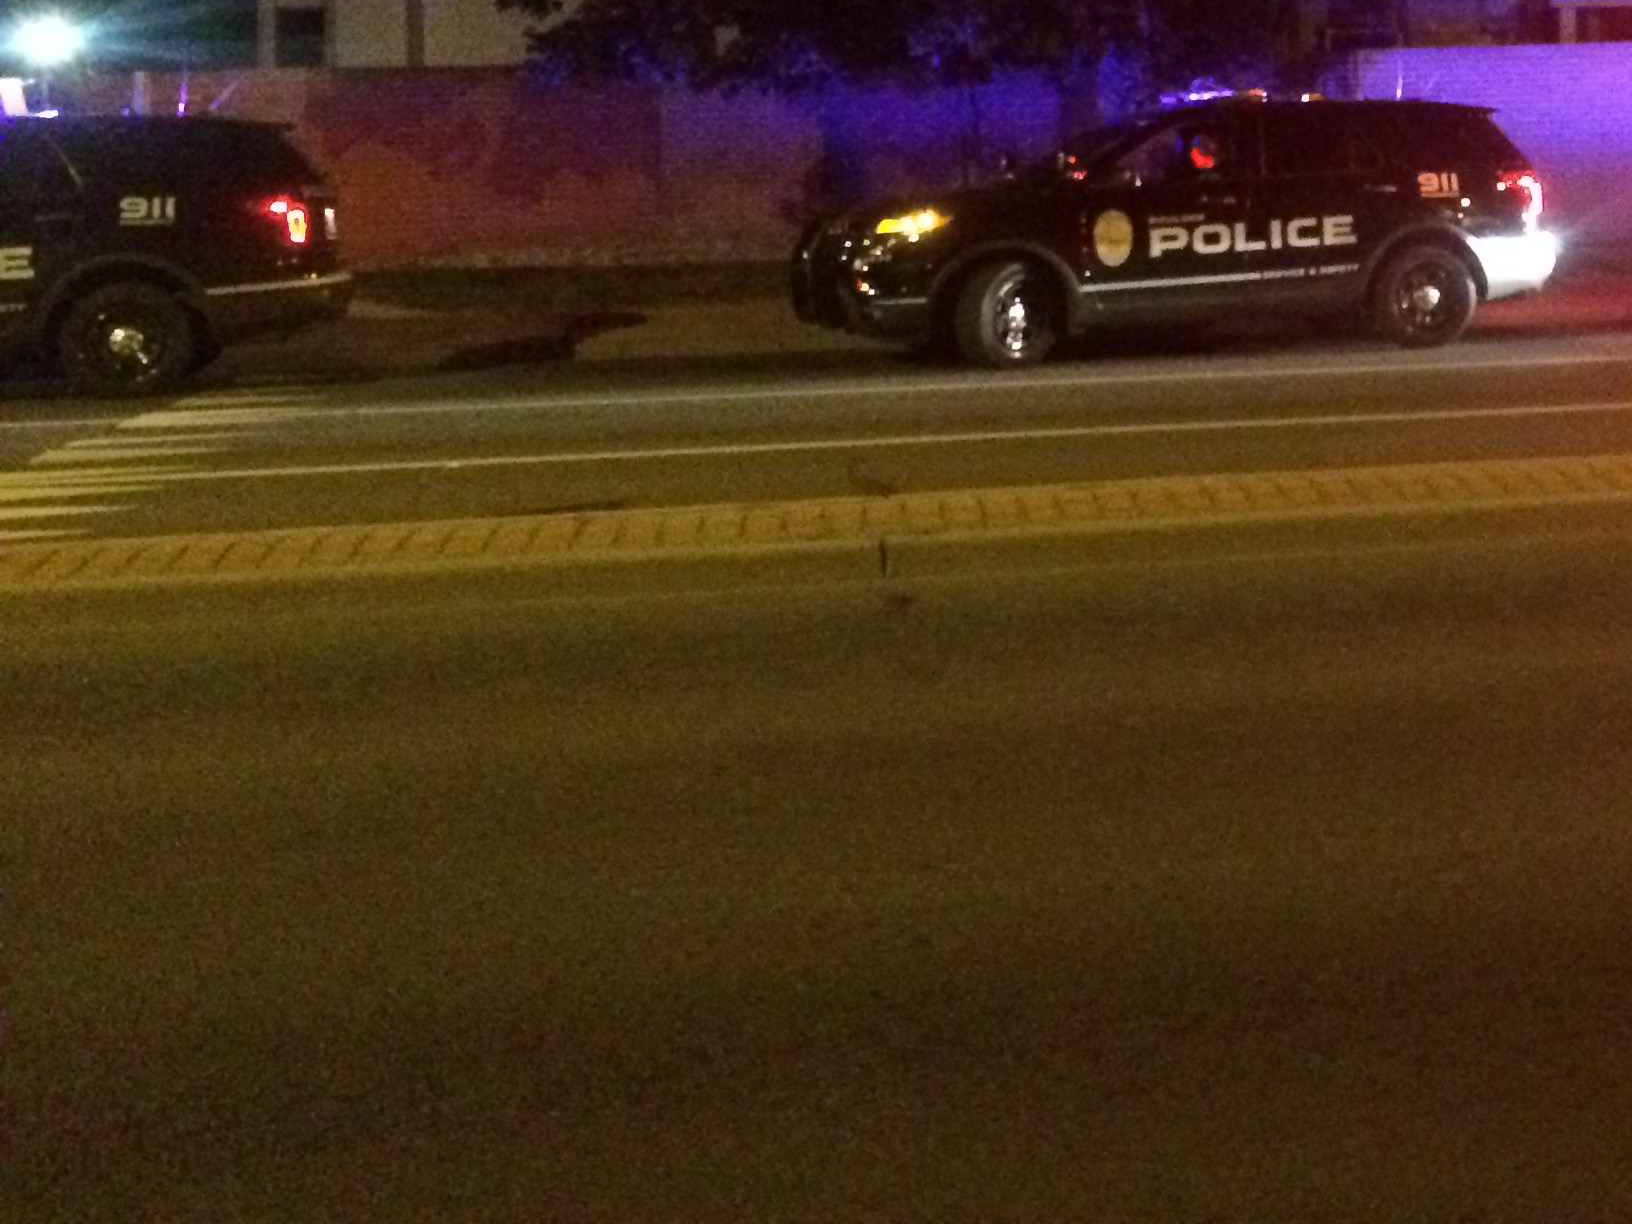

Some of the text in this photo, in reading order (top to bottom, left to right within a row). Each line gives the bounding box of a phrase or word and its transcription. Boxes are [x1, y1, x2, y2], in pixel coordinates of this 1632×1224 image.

[1417, 172, 1460, 193] 911
[119, 196, 177, 219] 911
[1148, 214, 1358, 258] POLICE
